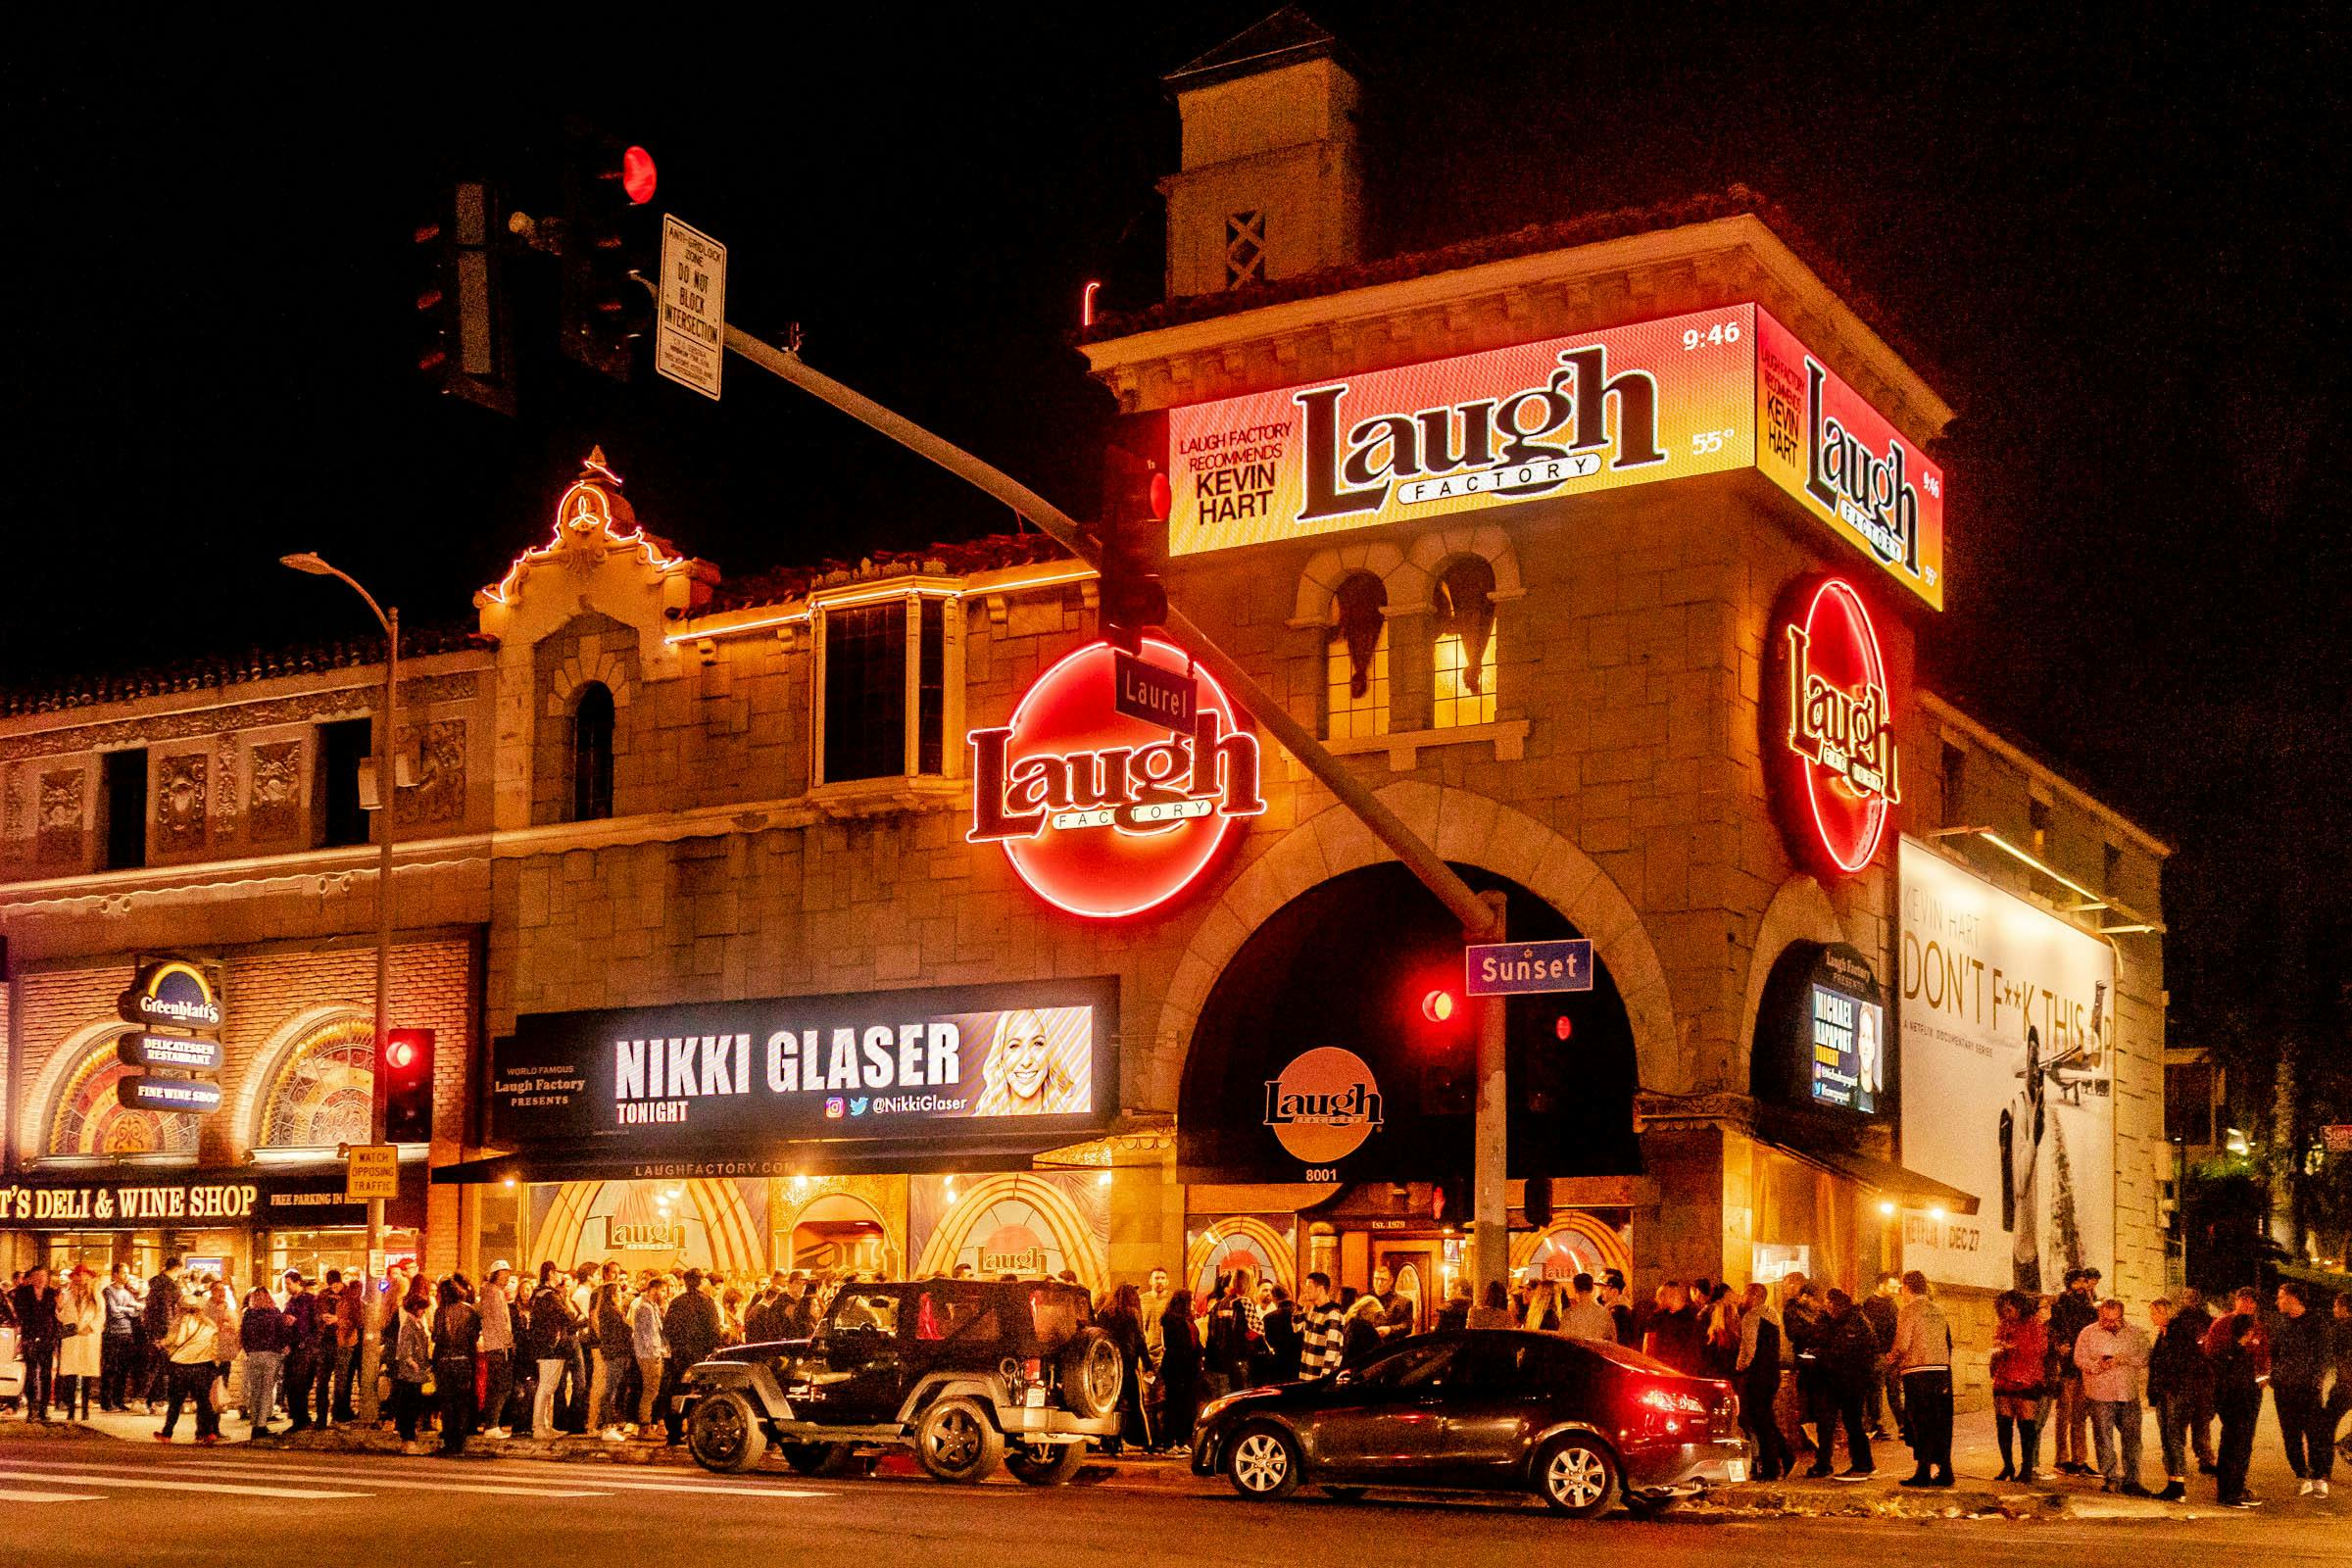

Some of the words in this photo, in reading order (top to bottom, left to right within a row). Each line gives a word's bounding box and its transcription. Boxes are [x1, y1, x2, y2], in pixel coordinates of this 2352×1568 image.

[669, 226, 721, 264] ANTI-GRIDLOCK
[685, 249, 704, 268] ZONE
[678, 262, 690, 283] DO
[694, 270, 709, 294] NOT
[679, 287, 705, 317] BLOCK
[664, 303, 718, 345] INTERSECTION
[1683, 321, 1740, 351] 9:46
[1768, 391, 1799, 441] KEVIN
[1180, 433, 1226, 455] LAUGH
[1229, 421, 1292, 445] FACTORY
[1293, 344, 1669, 524] Laugh
[1769, 421, 1797, 468] HART
[1189, 444, 1283, 472] RECOMMENDS
[1804, 355, 1921, 579] Laugh
[1197, 463, 1275, 499] KEVIN
[1415, 459, 1589, 500] FACTORY
[1200, 492, 1273, 525] HART
[1844, 505, 1901, 561] FACTORY
[1126, 669, 1187, 718] Laurel
[1788, 623, 1900, 804] Laugh
[966, 709, 1267, 844] Laugh
[1058, 802, 1205, 828] FACTORY
[1904, 885, 1943, 931] KEVIN
[1948, 907, 1981, 950] HART
[1482, 954, 1577, 983] Sunset
[1904, 930, 1984, 1025] DON'T
[2041, 989, 2084, 1060] THIS
[140, 997, 220, 1024] Greenblatt's
[143, 1038, 216, 1055] DELICATESSEN
[147, 1050, 212, 1065] RESTAURANT
[614, 1033, 752, 1100] NIKKI
[767, 1022, 959, 1093] GLASER
[507, 1067, 537, 1076] WORLD
[538, 1065, 574, 1074] FAMOUS
[137, 1086, 164, 1098] FINE
[165, 1088, 192, 1101] WINE
[192, 1091, 220, 1103] SHOP
[494, 1080, 532, 1094] Laugh
[536, 1078, 586, 1092] Factory
[512, 1096, 568, 1106] PRESENTS
[616, 1101, 688, 1124] TONIGHT
[872, 1094, 967, 1114] @NikkiGlaser
[1263, 1080, 1385, 1128] Laugh
[352, 1166, 394, 1177] OPPOSING
[359, 1152, 389, 1162] WATCH
[354, 1181, 392, 1192] TRAFFIC
[1305, 1168, 1337, 1182] 8001
[34, 1189, 90, 1219] DELI
[95, 1188, 114, 1219] &
[118, 1187, 185, 1218] WINE
[189, 1185, 257, 1217] SHOP
[270, 1194, 293, 1206] FREE
[294, 1193, 331, 1205] PARKING
[332, 1193, 343, 1205] IN
[603, 1214, 688, 1250] Laugh
[1948, 1225, 1967, 1250] DEC
[1968, 1228, 1980, 1252] 27
[974, 1246, 1049, 1274] Laugh
